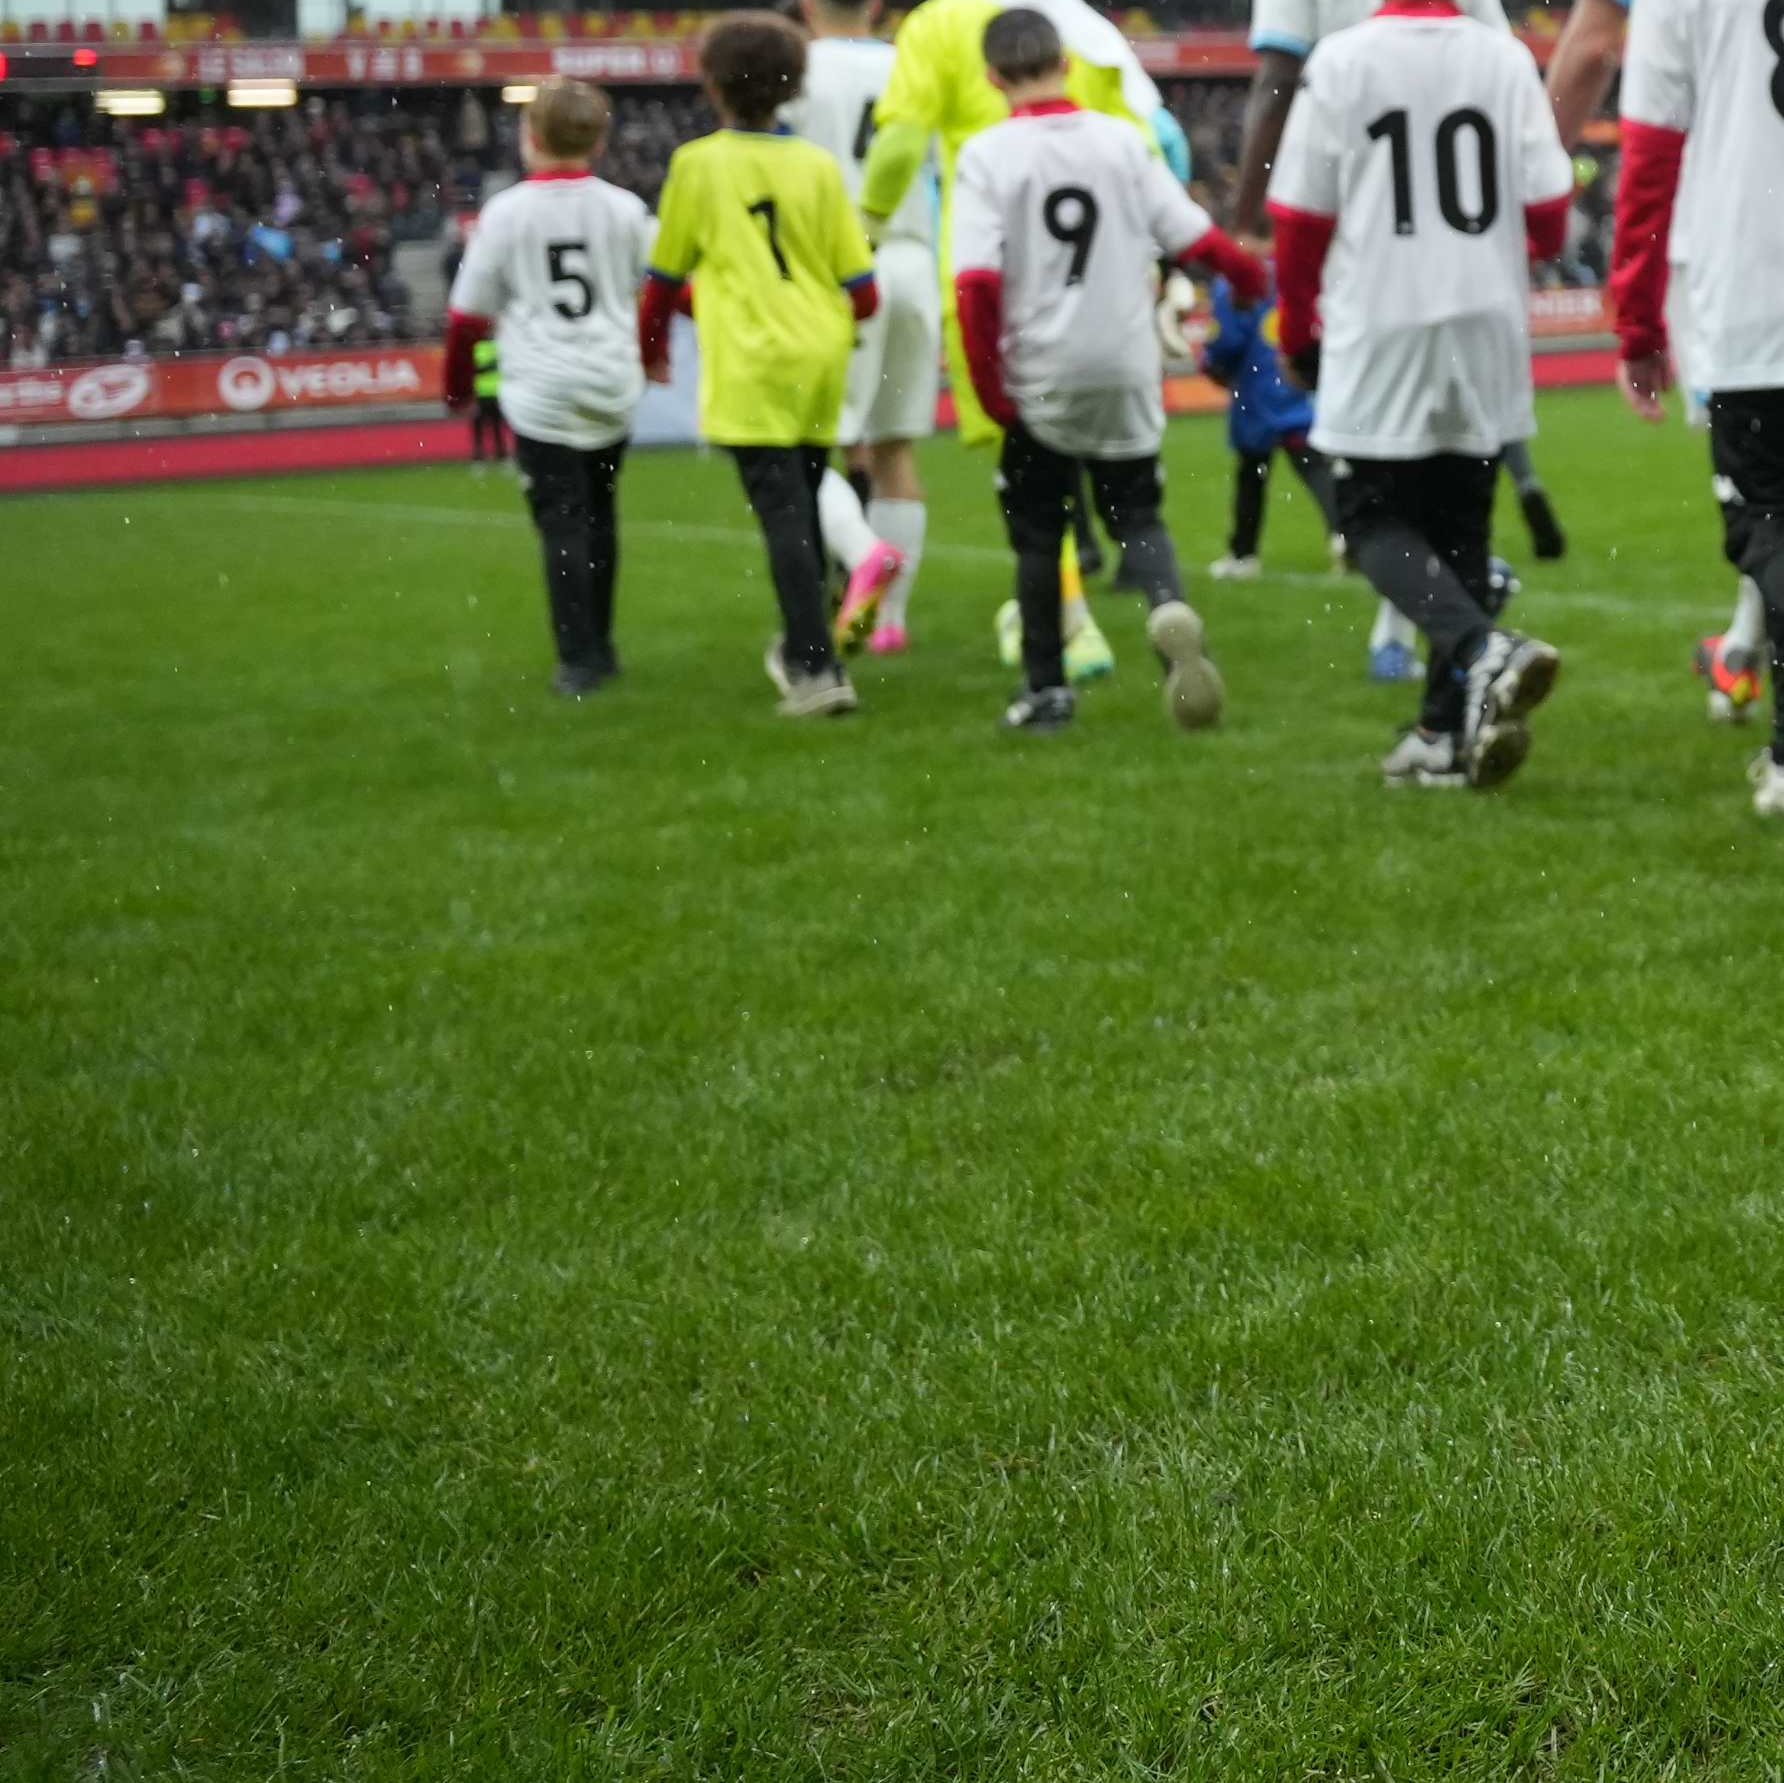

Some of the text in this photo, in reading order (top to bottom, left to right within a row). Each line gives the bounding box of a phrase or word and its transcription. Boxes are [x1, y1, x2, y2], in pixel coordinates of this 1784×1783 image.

[1365, 106, 1500, 237] 10
[545, 240, 596, 322] 5
[1041, 185, 1099, 287] 9
[277, 358, 421, 396] VEOLIA
